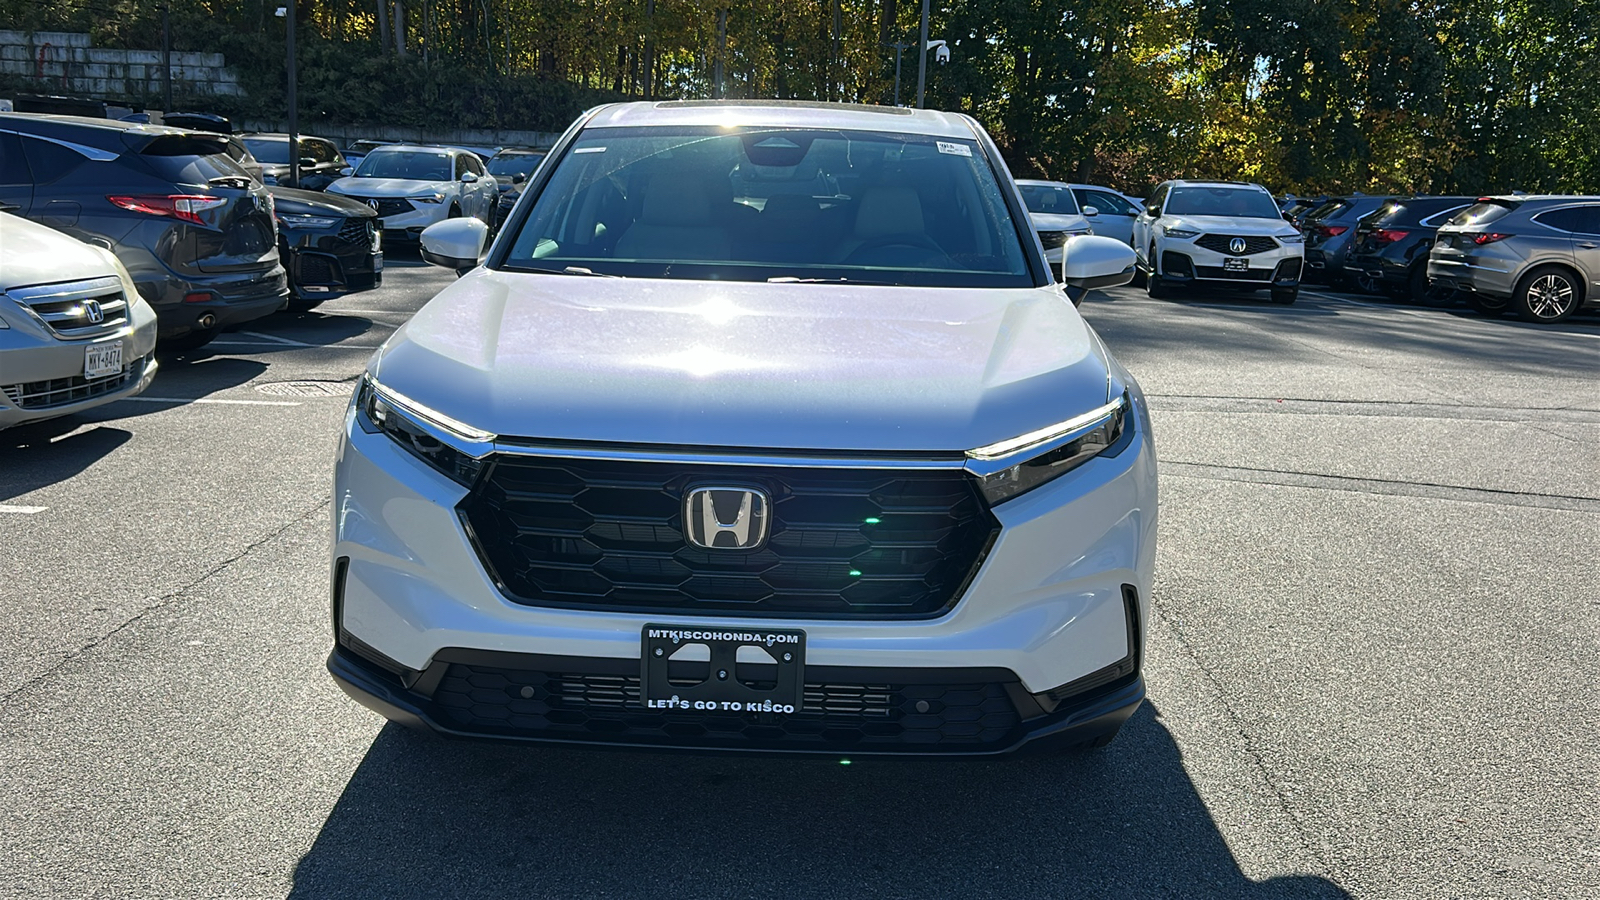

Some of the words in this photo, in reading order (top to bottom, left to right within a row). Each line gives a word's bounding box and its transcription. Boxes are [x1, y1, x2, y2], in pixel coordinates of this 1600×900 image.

[648, 629, 799, 644] MTKISCOHONDA.COM
[648, 699, 690, 709] LET'S
[694, 700, 717, 710] GO
[721, 701, 742, 711] TO
[746, 702, 795, 714] KISCO
